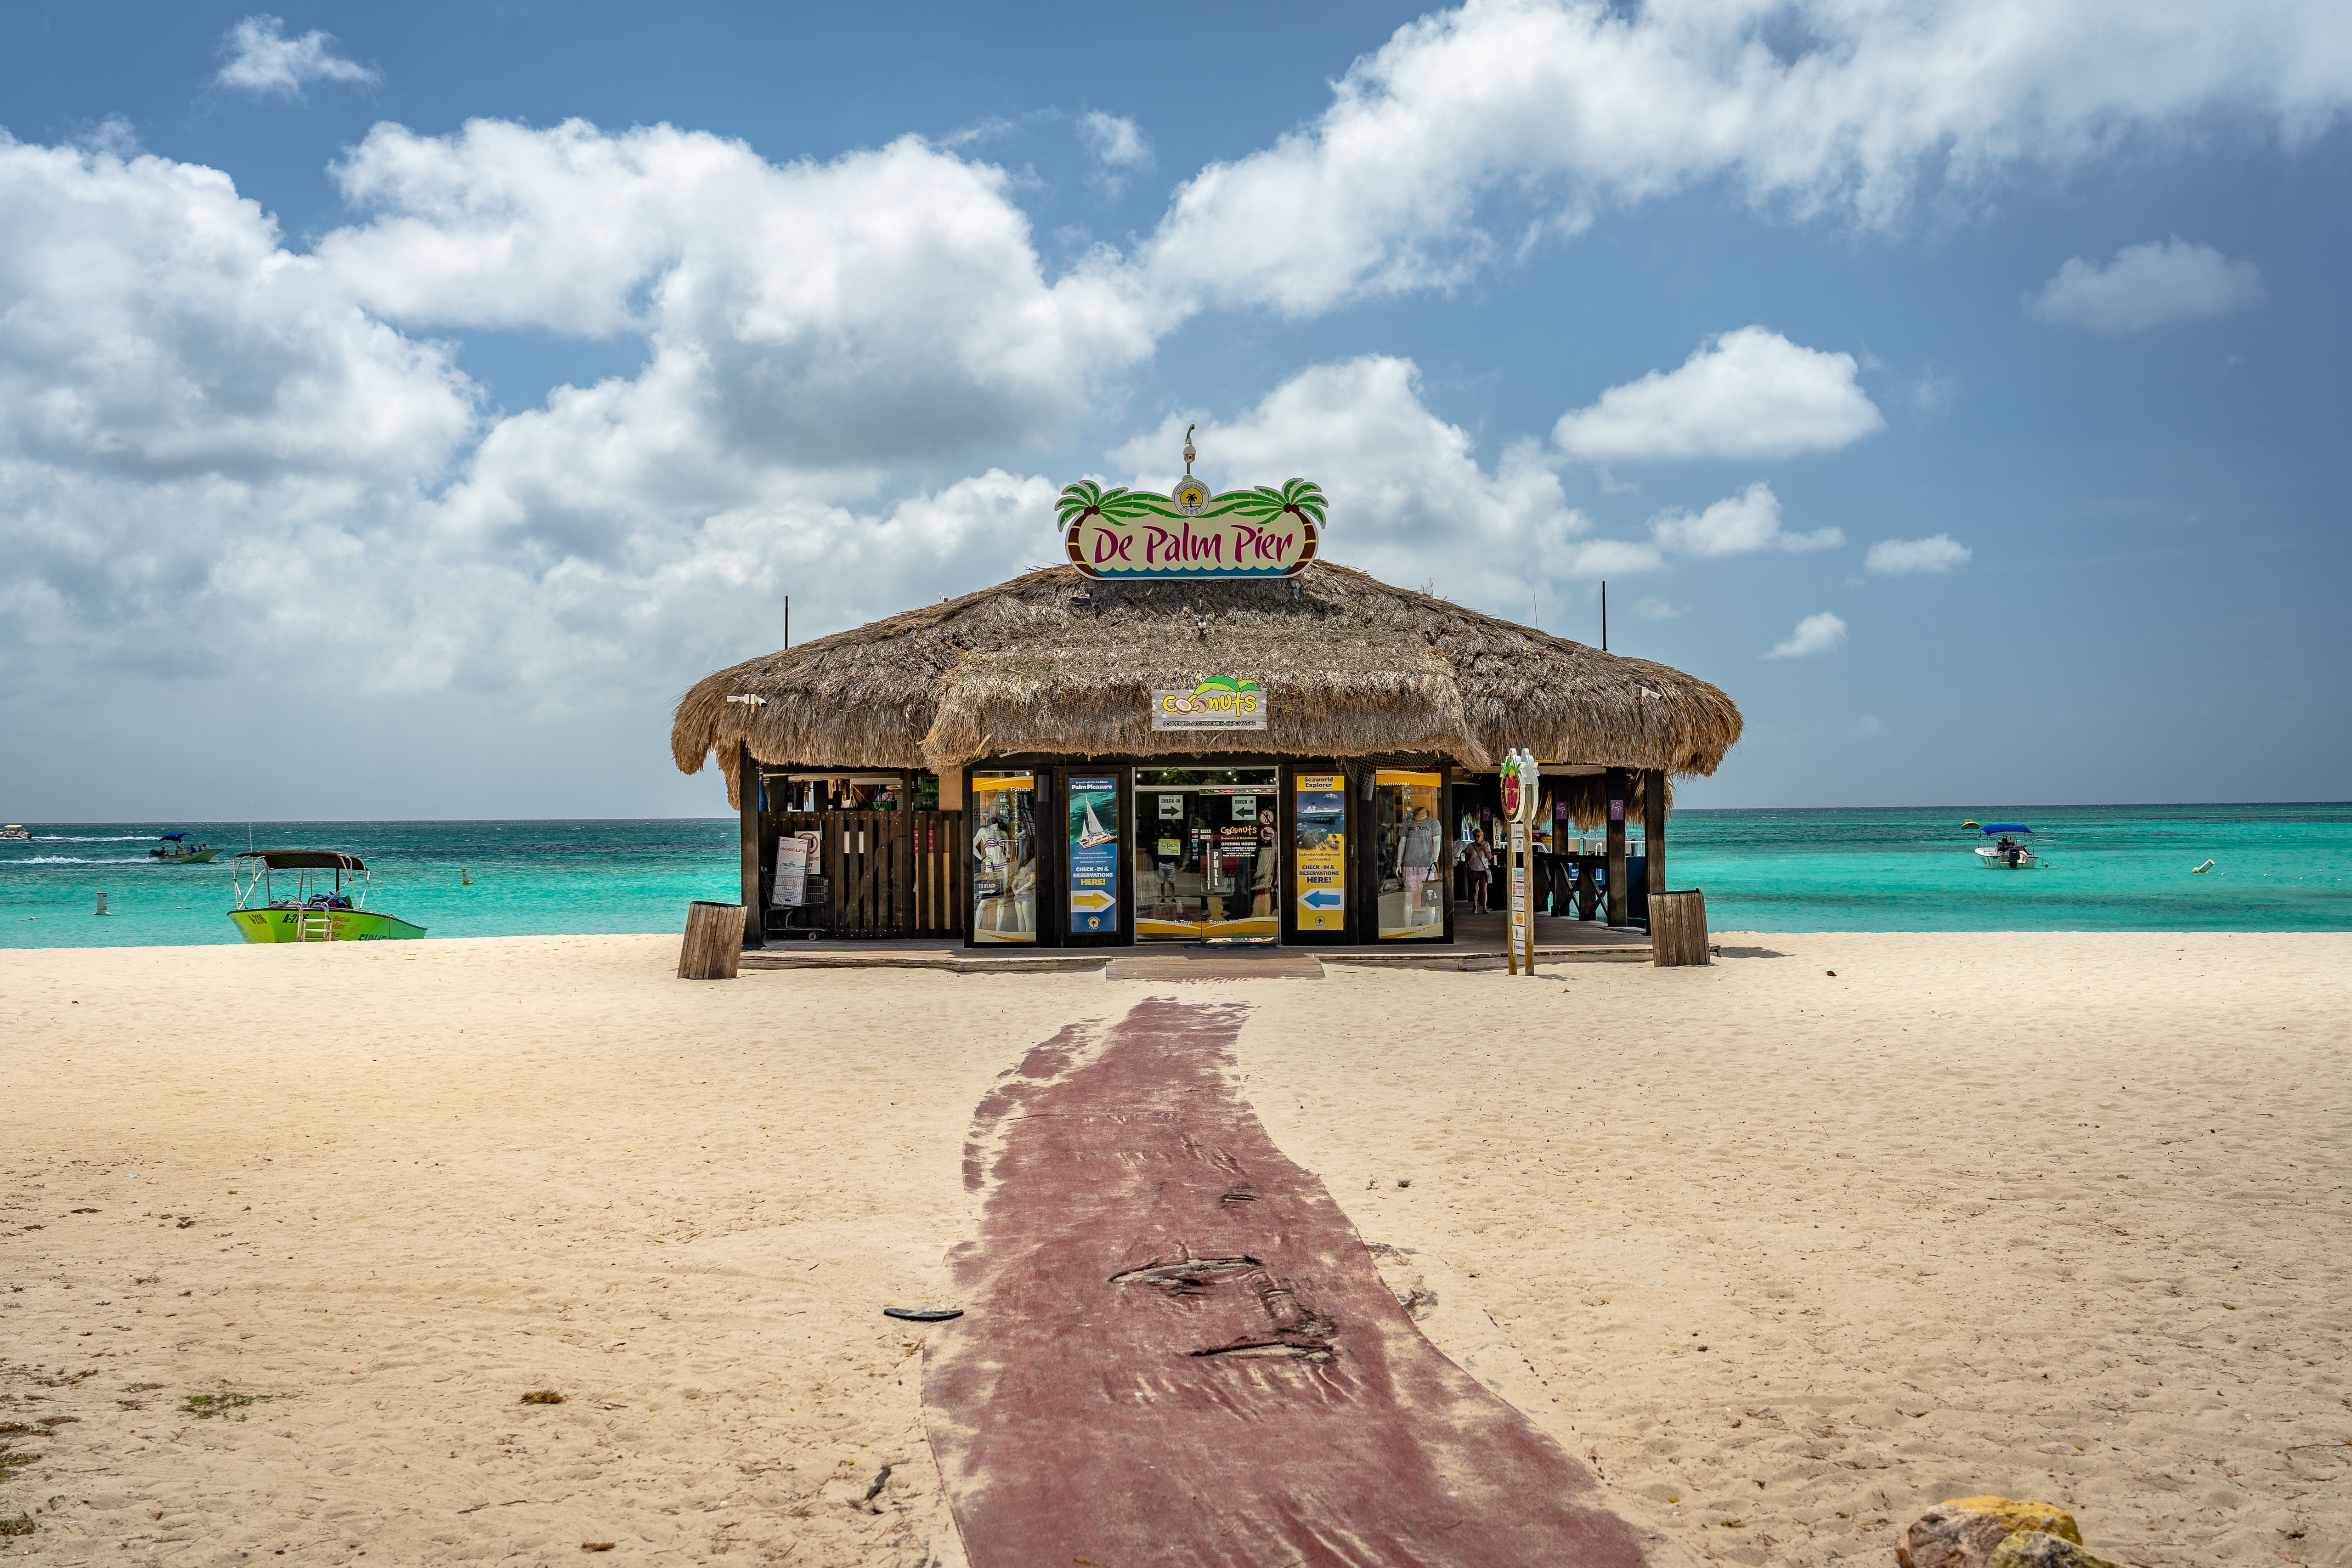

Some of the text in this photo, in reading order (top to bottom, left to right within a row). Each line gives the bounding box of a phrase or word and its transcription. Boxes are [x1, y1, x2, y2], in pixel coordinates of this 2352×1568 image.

[1194, 483, 1206, 496] TOURS
[1092, 522, 1293, 564] De Palm Pier
[282, 914, 309, 923] A-216
